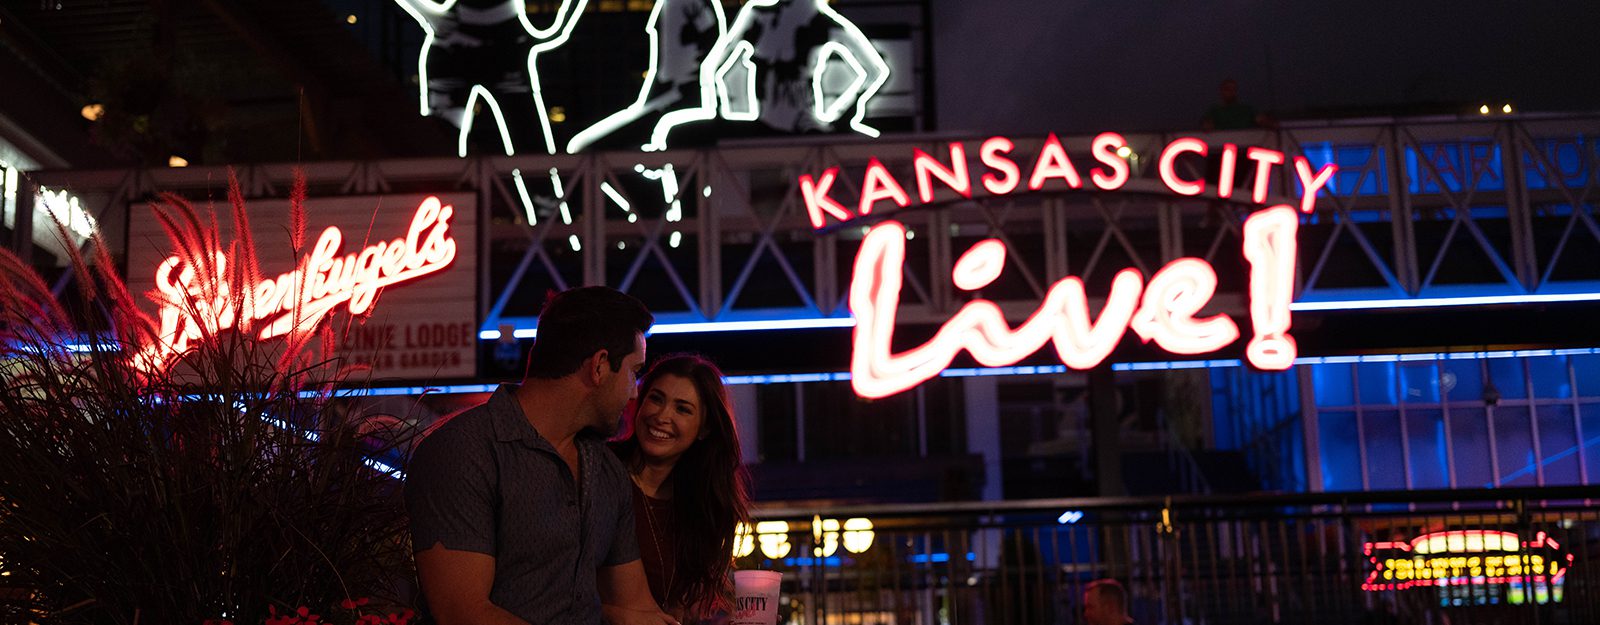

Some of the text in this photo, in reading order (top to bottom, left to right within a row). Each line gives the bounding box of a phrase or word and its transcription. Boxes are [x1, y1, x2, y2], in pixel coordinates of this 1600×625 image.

[799, 131, 1131, 229] KANSAS
[1157, 136, 1339, 213] CITY
[404, 322, 472, 348] LODGE
[850, 204, 1299, 398] Live!
